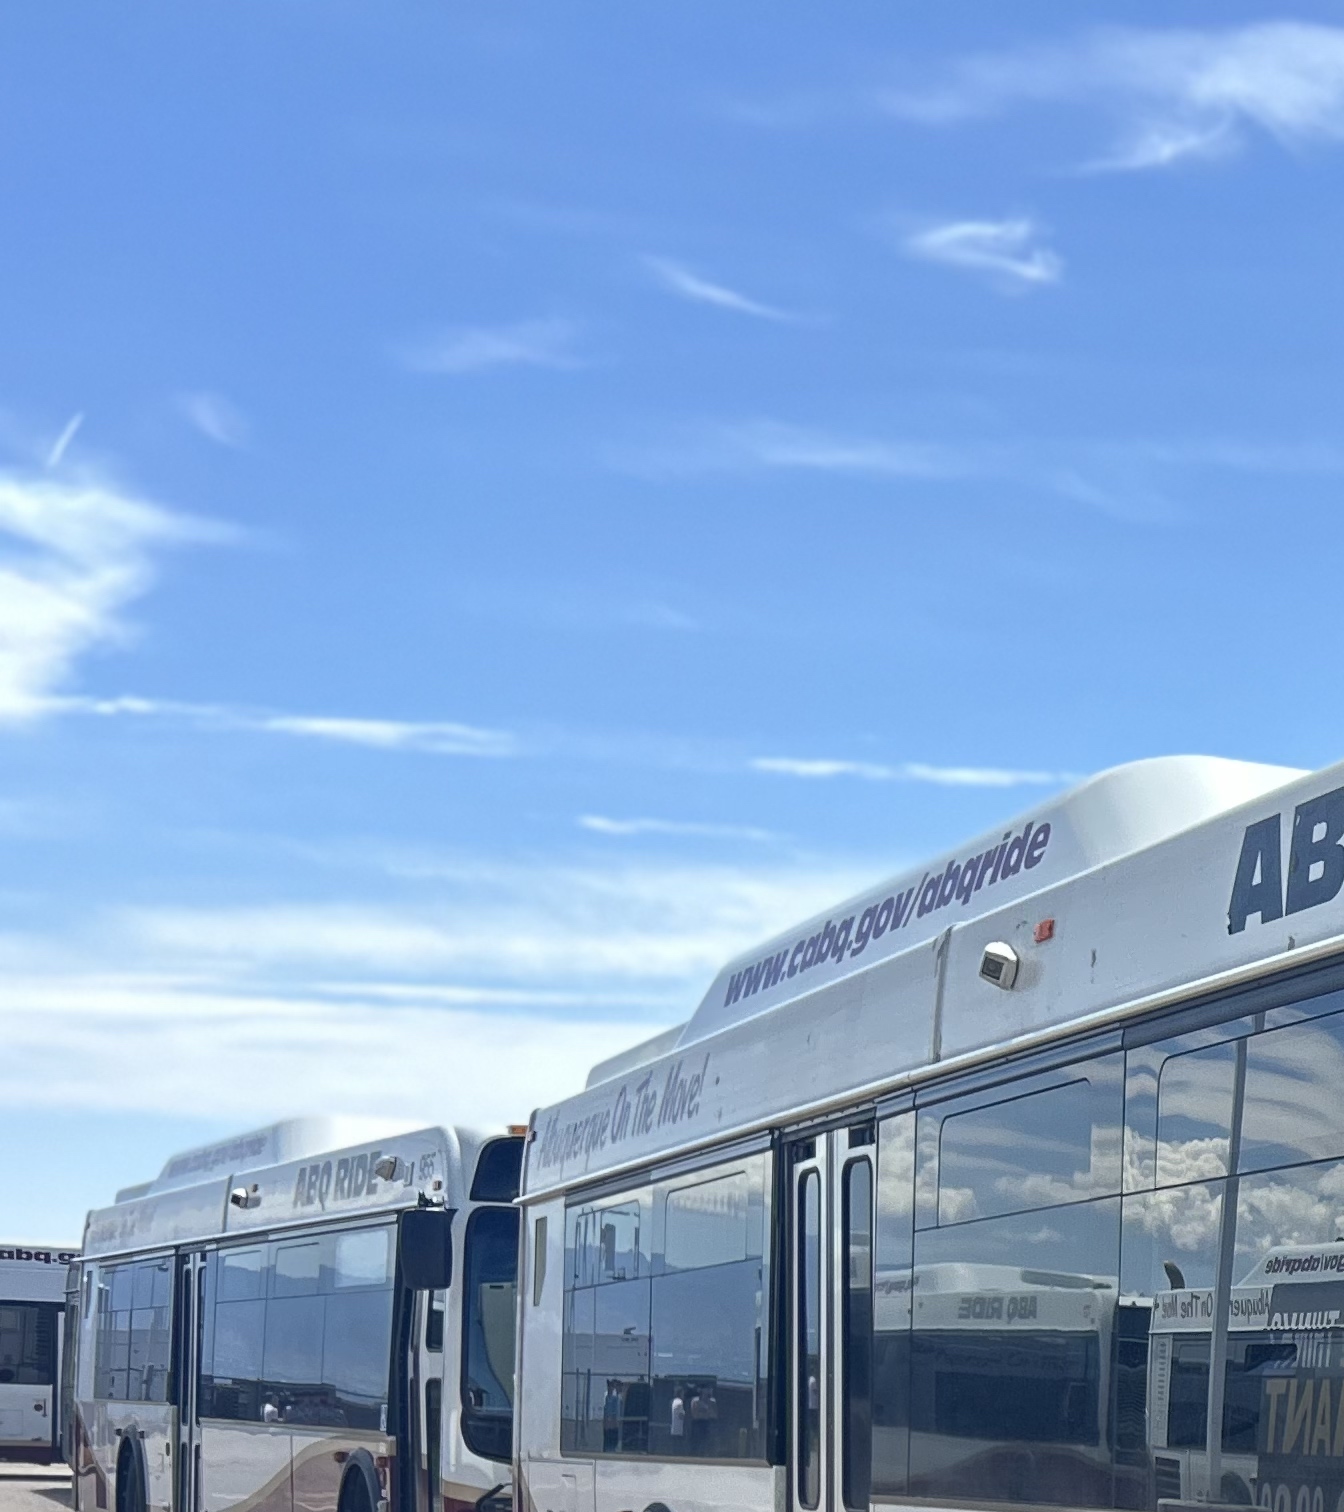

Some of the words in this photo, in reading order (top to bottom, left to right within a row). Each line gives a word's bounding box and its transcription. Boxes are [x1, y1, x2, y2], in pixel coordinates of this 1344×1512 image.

[724, 821, 1051, 1007] www.cabq.gov/abqride
[611, 1084, 631, 1145] On
[632, 1070, 657, 1137] The
[657, 1052, 710, 1129] Move!
[294, 1160, 333, 1211] ABQ
[334, 1151, 383, 1202] RIDE
